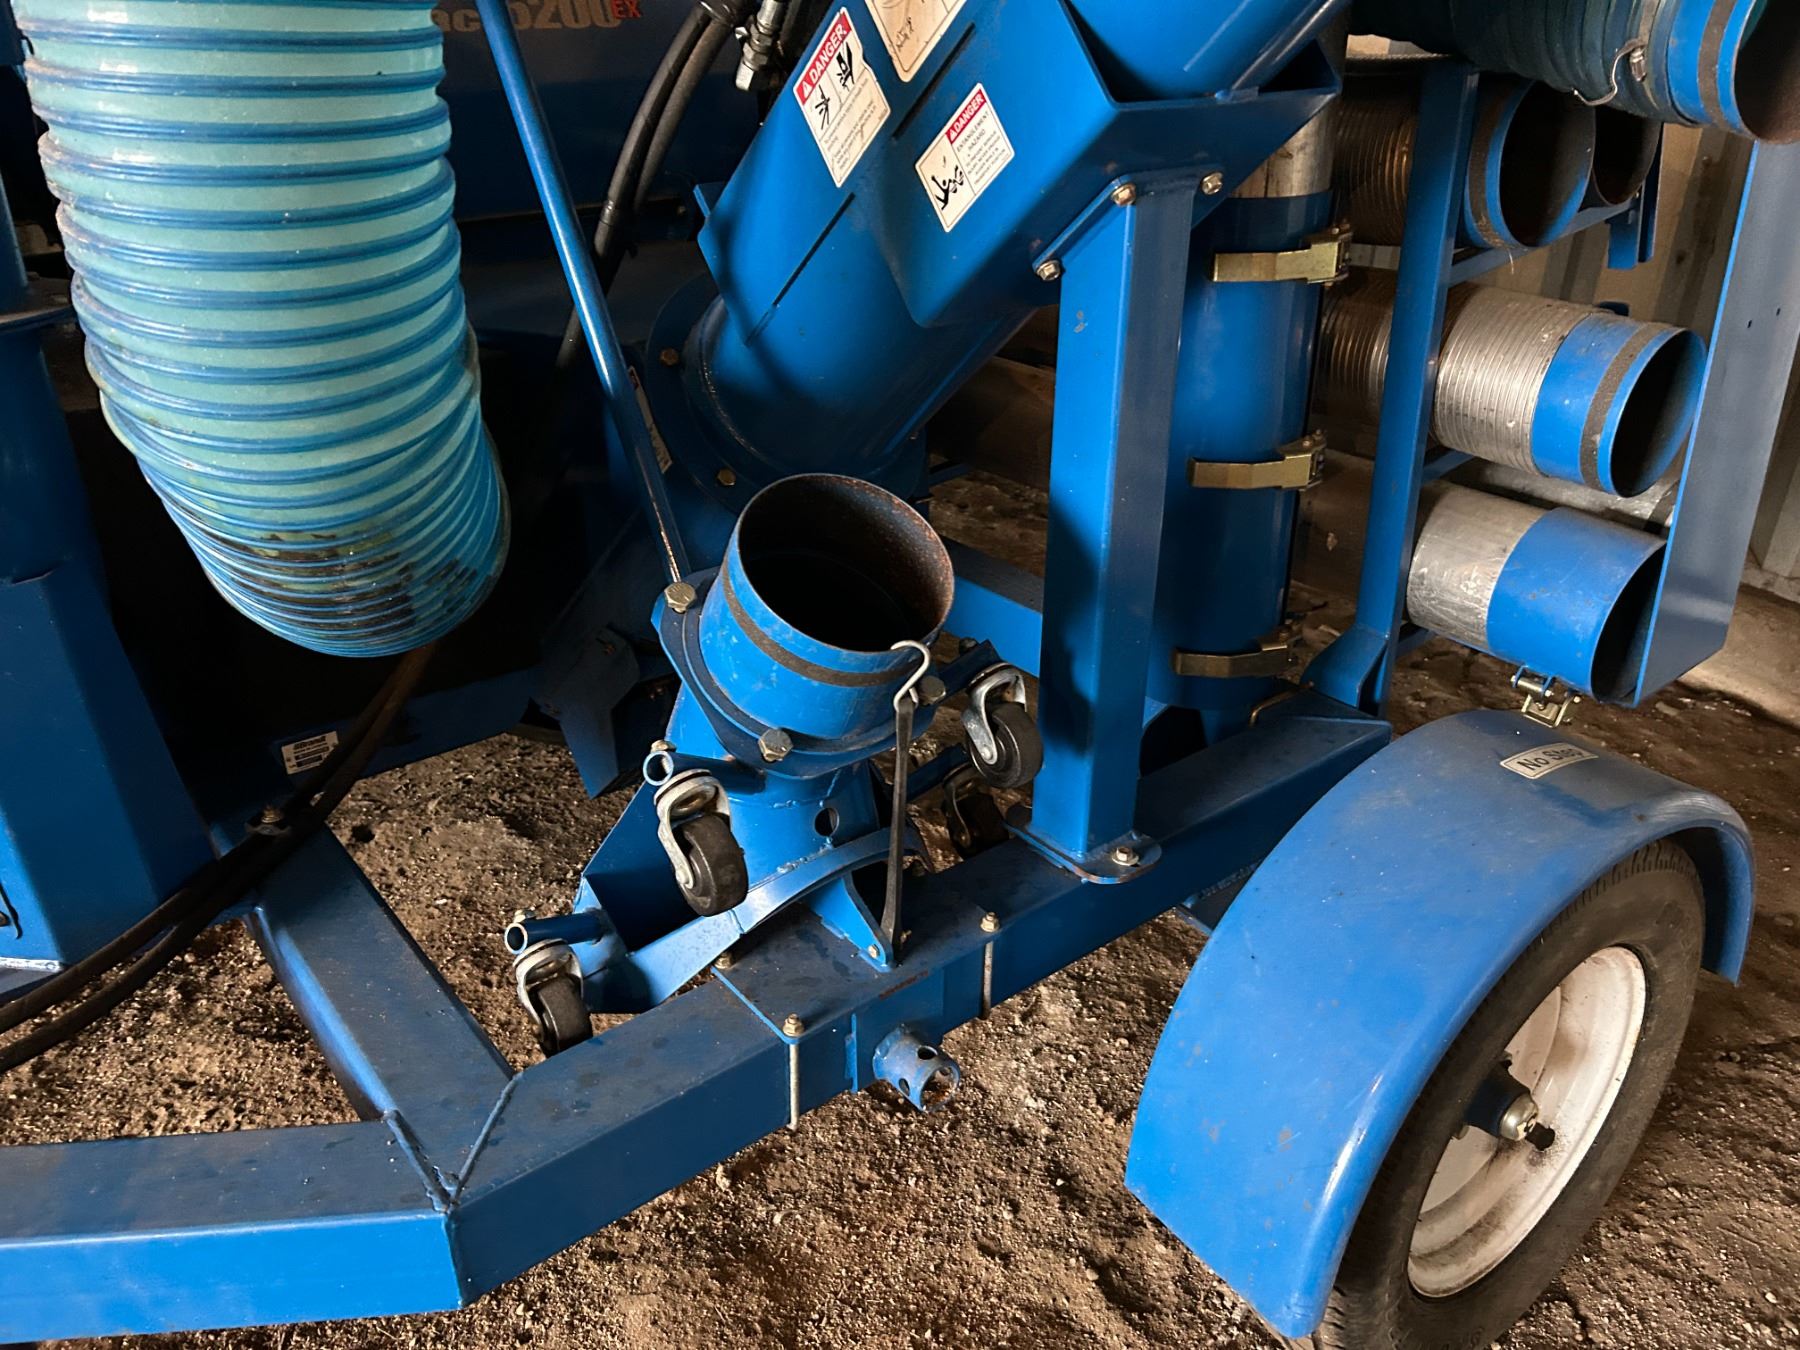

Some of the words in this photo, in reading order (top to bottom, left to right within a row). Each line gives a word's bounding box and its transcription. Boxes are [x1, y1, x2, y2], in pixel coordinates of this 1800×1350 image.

[809, 22, 848, 85] DANGER
[952, 92, 984, 133] DANGER
[1517, 757, 1550, 771] No
[1542, 748, 1584, 761] Step
